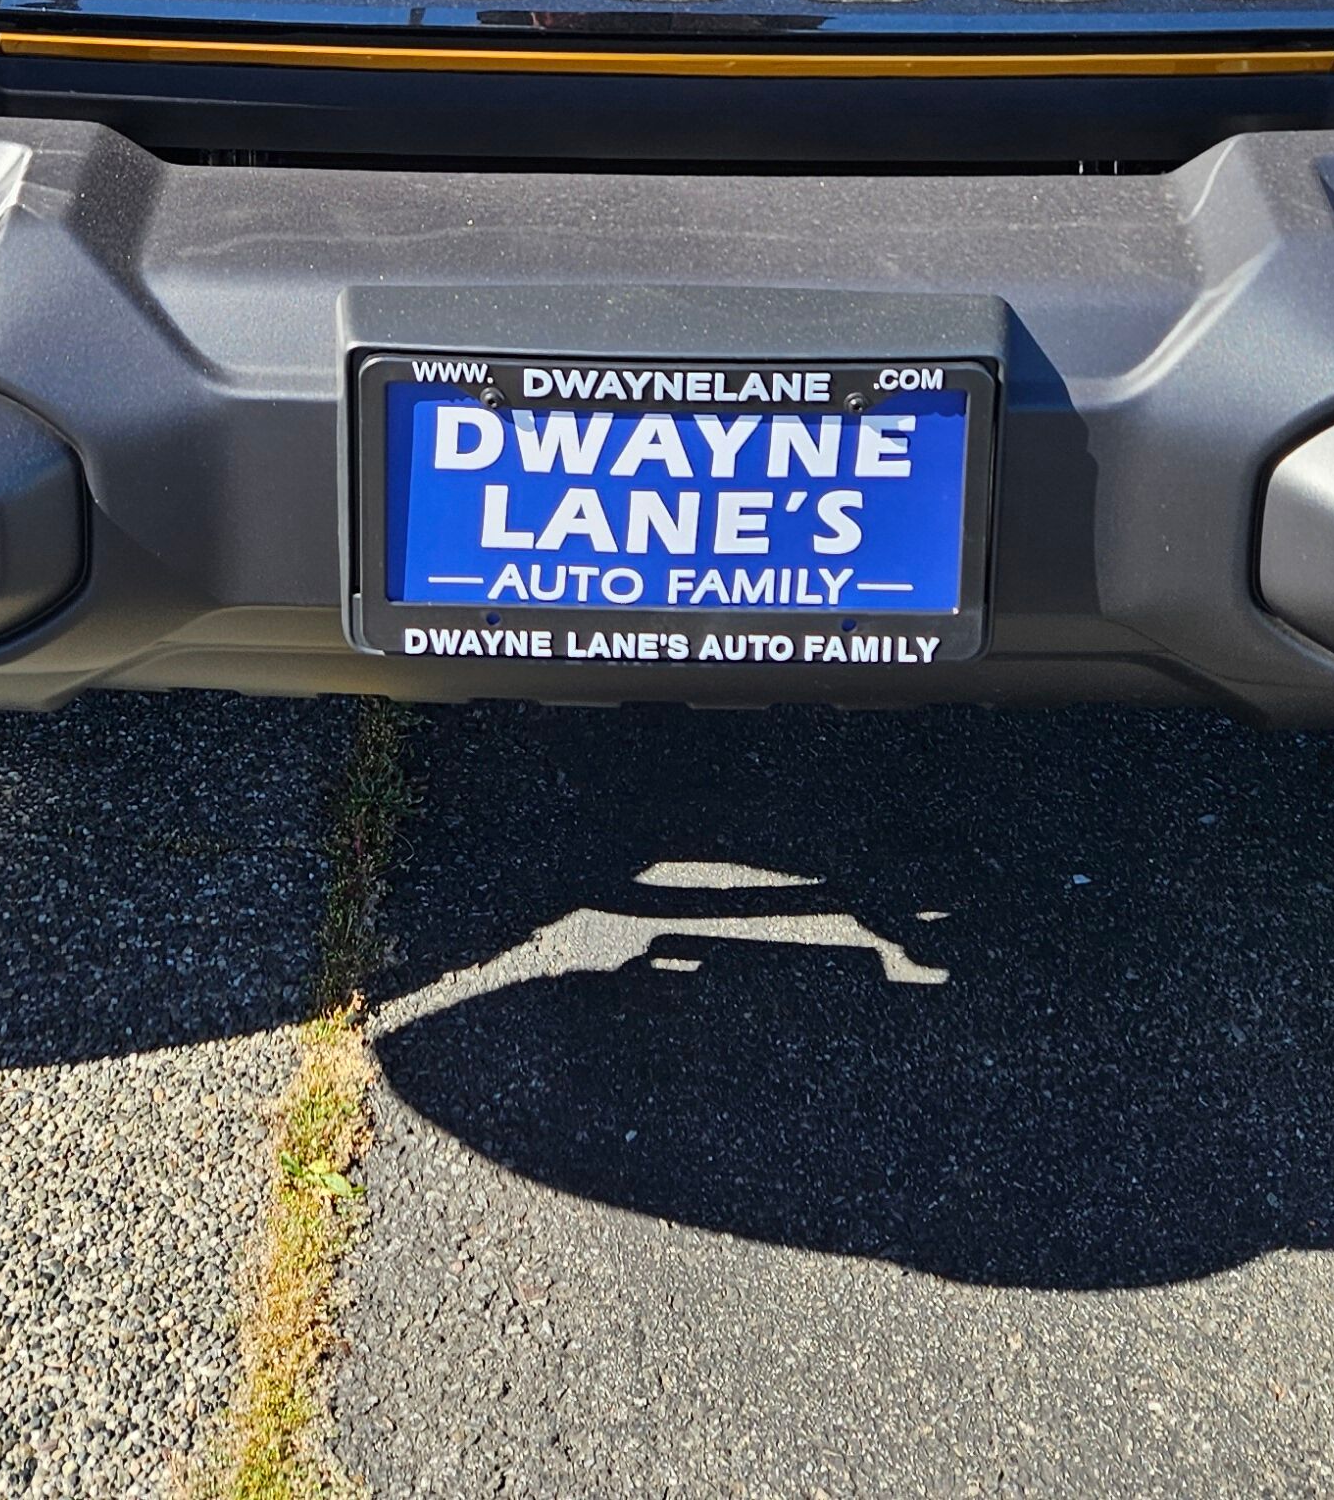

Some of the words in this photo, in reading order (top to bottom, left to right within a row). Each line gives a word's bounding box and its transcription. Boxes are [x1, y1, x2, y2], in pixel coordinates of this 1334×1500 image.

[411, 361, 494, 386] WWW.
[523, 368, 831, 402] DWAYNELANE
[873, 368, 943, 392] .COM
[433, 405, 917, 479] DWAYNE
[481, 485, 864, 556] LANE'S
[487, 563, 644, 604] AUTO
[668, 567, 854, 607] FAMILY
[404, 628, 553, 658] DWAYNE
[567, 630, 691, 660] LANE'S
[698, 632, 796, 662] AUTO
[802, 633, 941, 664] FAMILY
